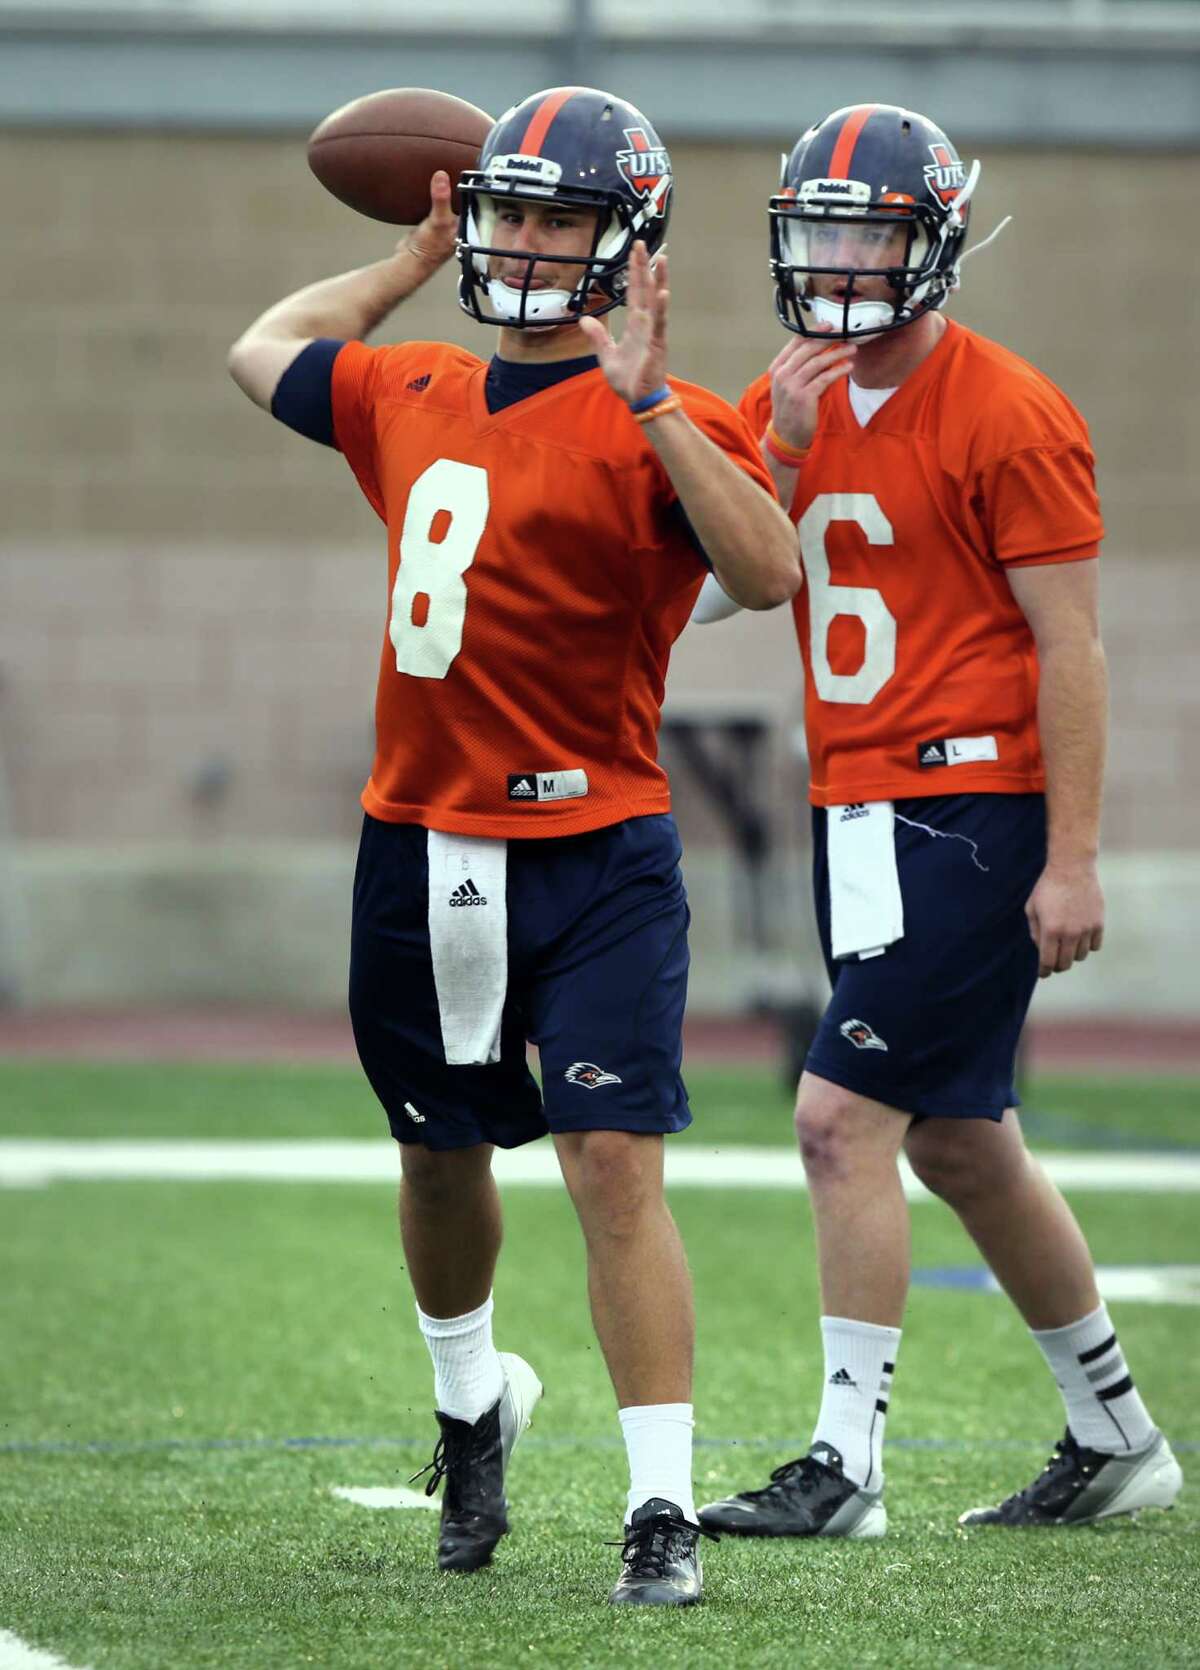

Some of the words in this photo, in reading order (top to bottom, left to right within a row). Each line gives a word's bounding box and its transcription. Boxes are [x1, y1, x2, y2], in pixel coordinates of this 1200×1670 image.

[389, 458, 490, 679] 8
[800, 493, 897, 704] 6
[952, 745, 962, 756] L
[543, 779, 554, 793] M
[449, 896, 488, 907] adidas
